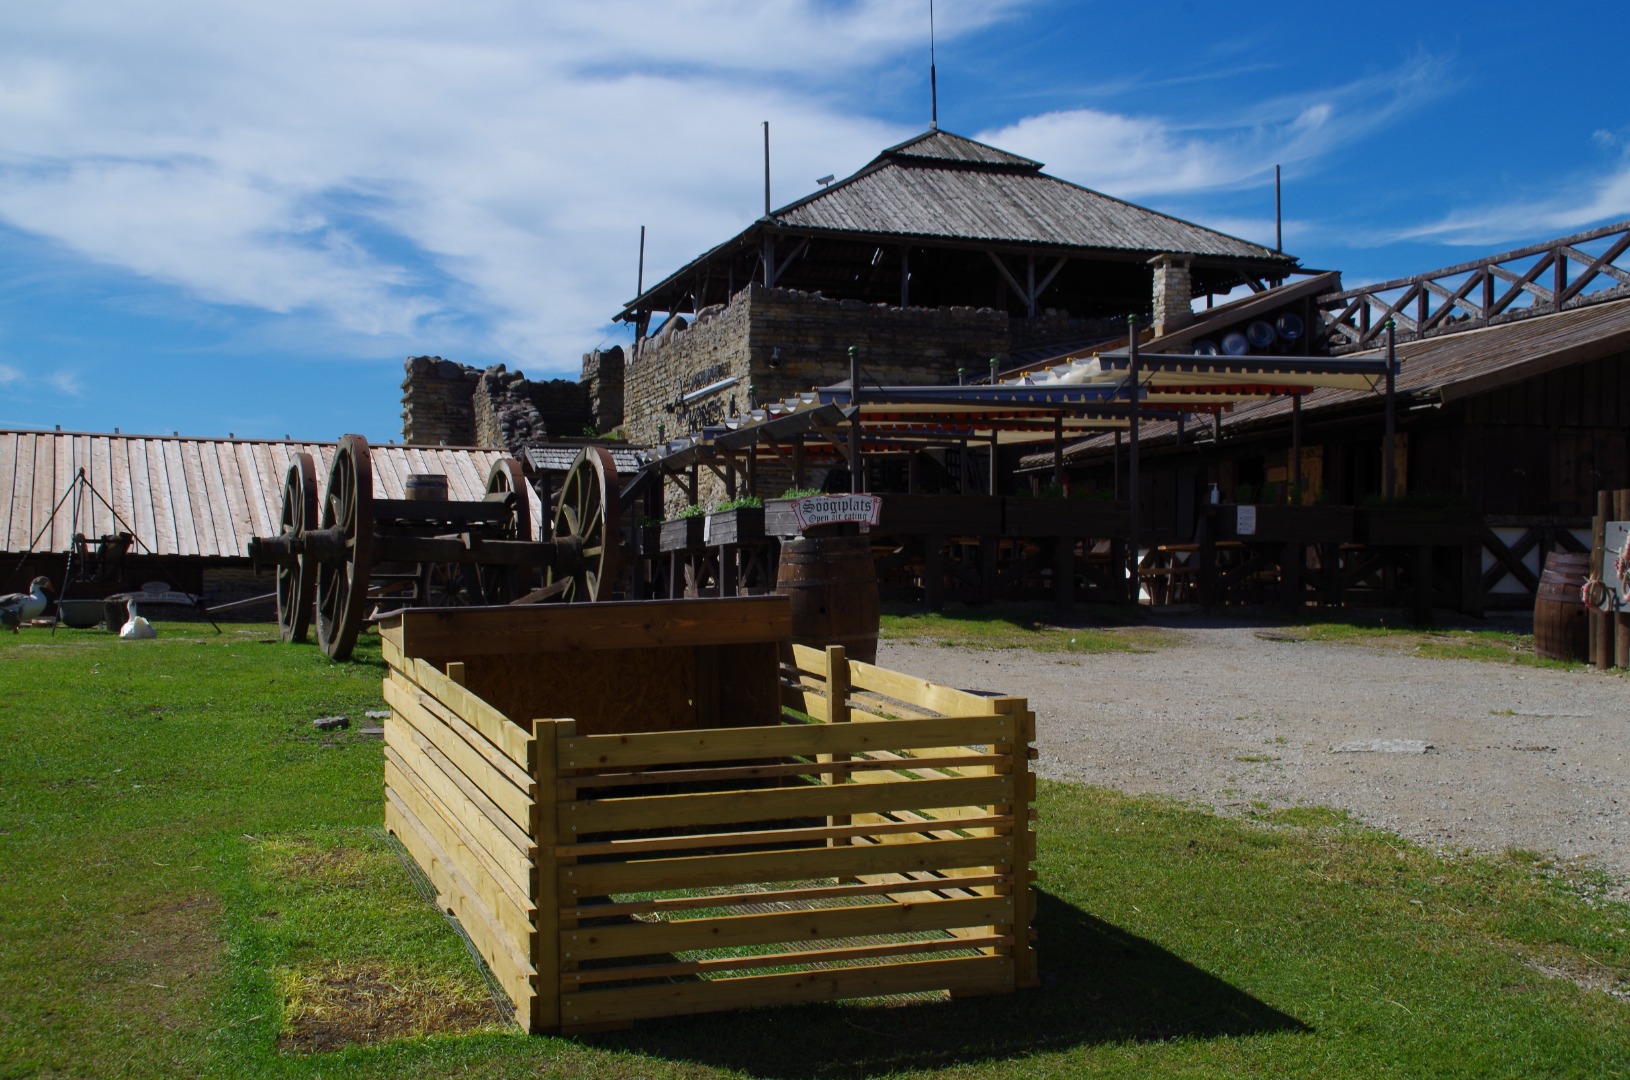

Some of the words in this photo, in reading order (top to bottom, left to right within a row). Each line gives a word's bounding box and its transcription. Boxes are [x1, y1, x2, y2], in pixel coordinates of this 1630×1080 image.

[803, 498, 872, 514] Söögiplats
[809, 514, 829, 523] Open
[832, 513, 842, 521] air
[844, 512, 867, 521] eating
